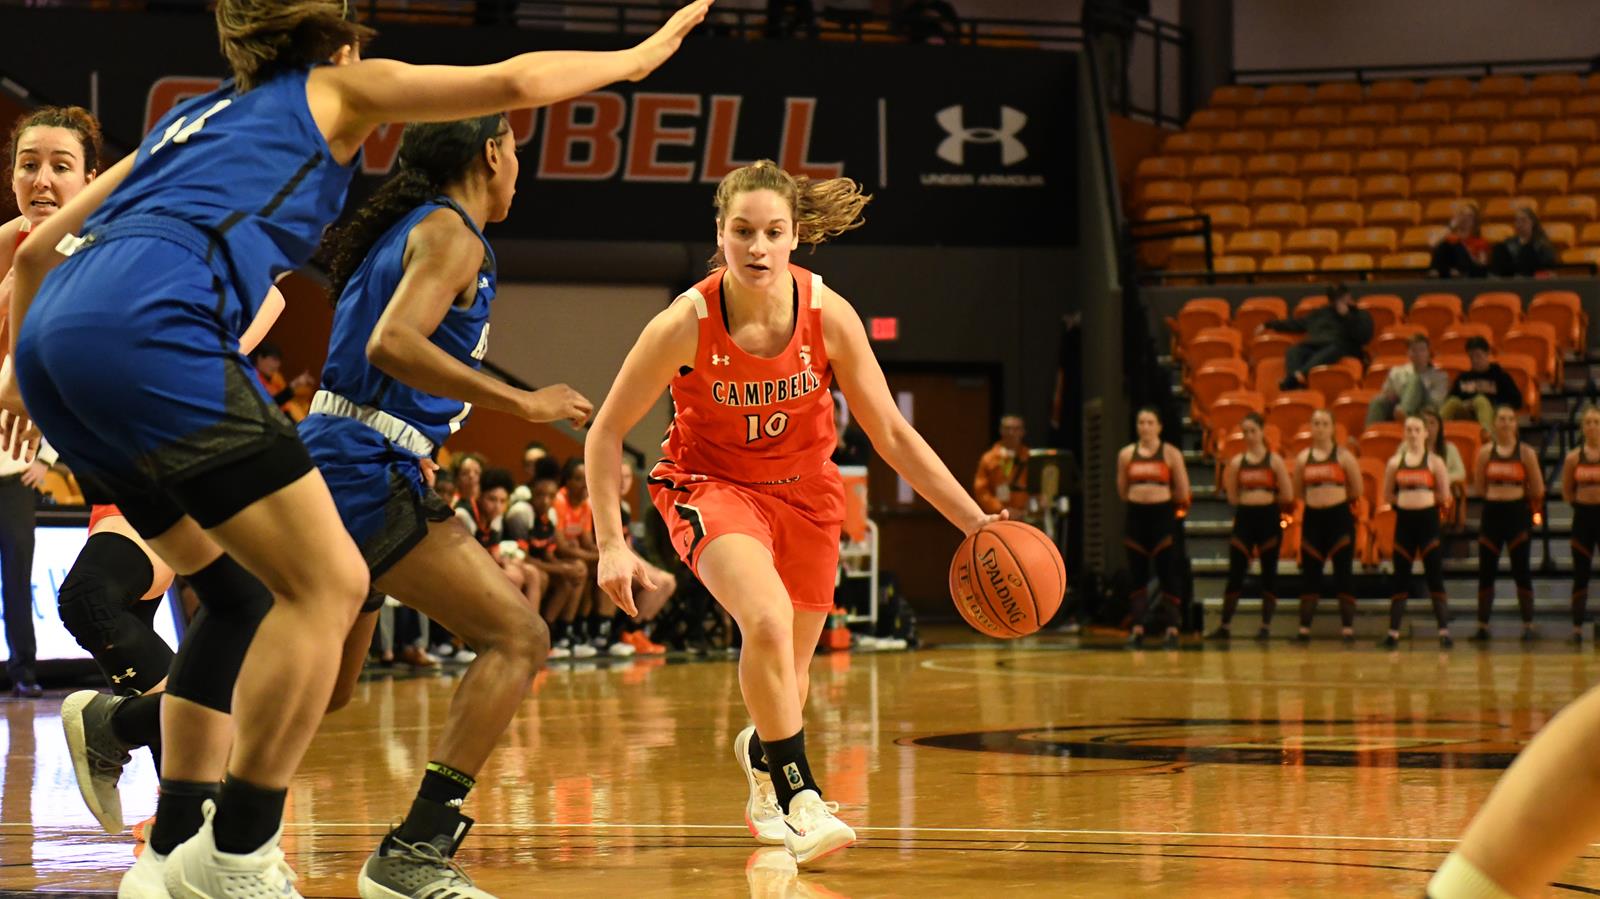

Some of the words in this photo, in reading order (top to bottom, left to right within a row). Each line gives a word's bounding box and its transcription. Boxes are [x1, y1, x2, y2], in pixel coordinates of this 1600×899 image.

[143, 75, 845, 184] CBELL
[920, 174, 974, 186] UNDER
[977, 175, 1045, 187] ARMOUR
[712, 364, 821, 407] CAMPBELL
[745, 410, 790, 445] 10
[978, 547, 1027, 624] SPALDING
